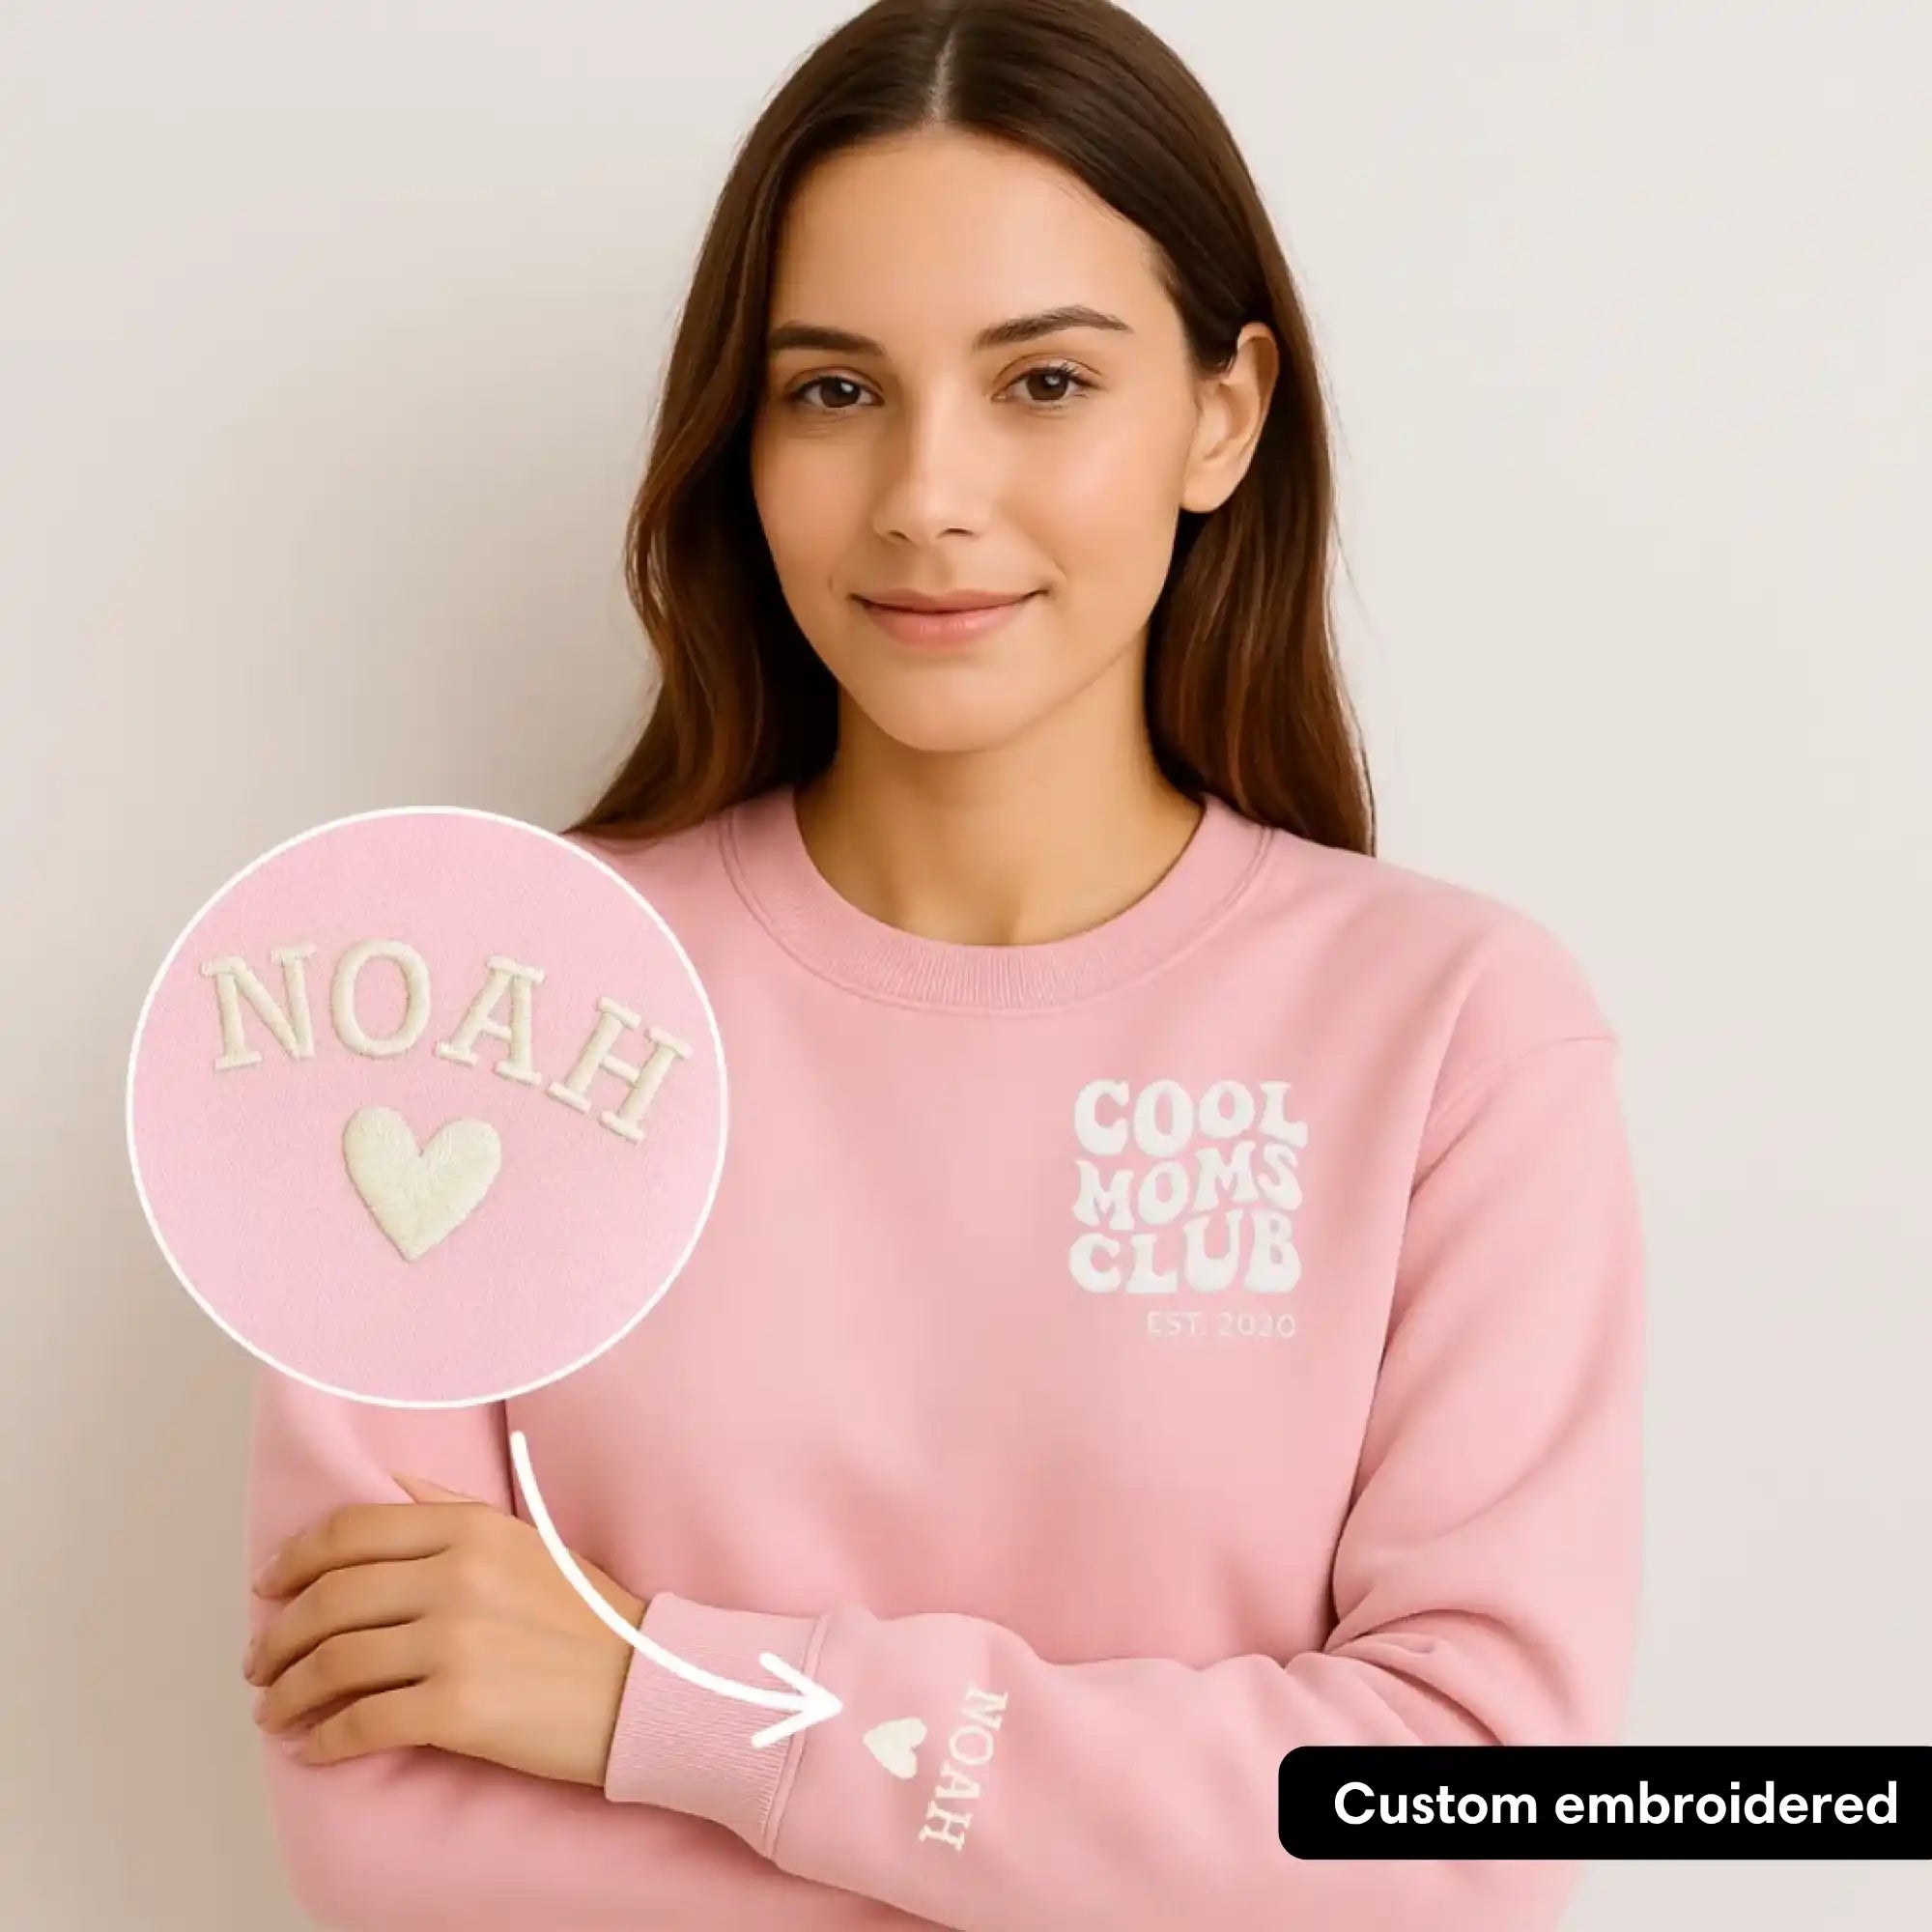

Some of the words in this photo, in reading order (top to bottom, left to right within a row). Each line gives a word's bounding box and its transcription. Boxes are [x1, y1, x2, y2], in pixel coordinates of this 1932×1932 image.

[200, 938, 693, 1144] NOAH
[1073, 1078, 1309, 1157] COOL
[1071, 1140, 1304, 1231] MOMS
[1067, 1208, 1302, 1293] CLUB
[1147, 1310, 1207, 1336] EST.
[1218, 1311, 1296, 1339] 2020
[919, 1686, 1009, 1852] NOAH
